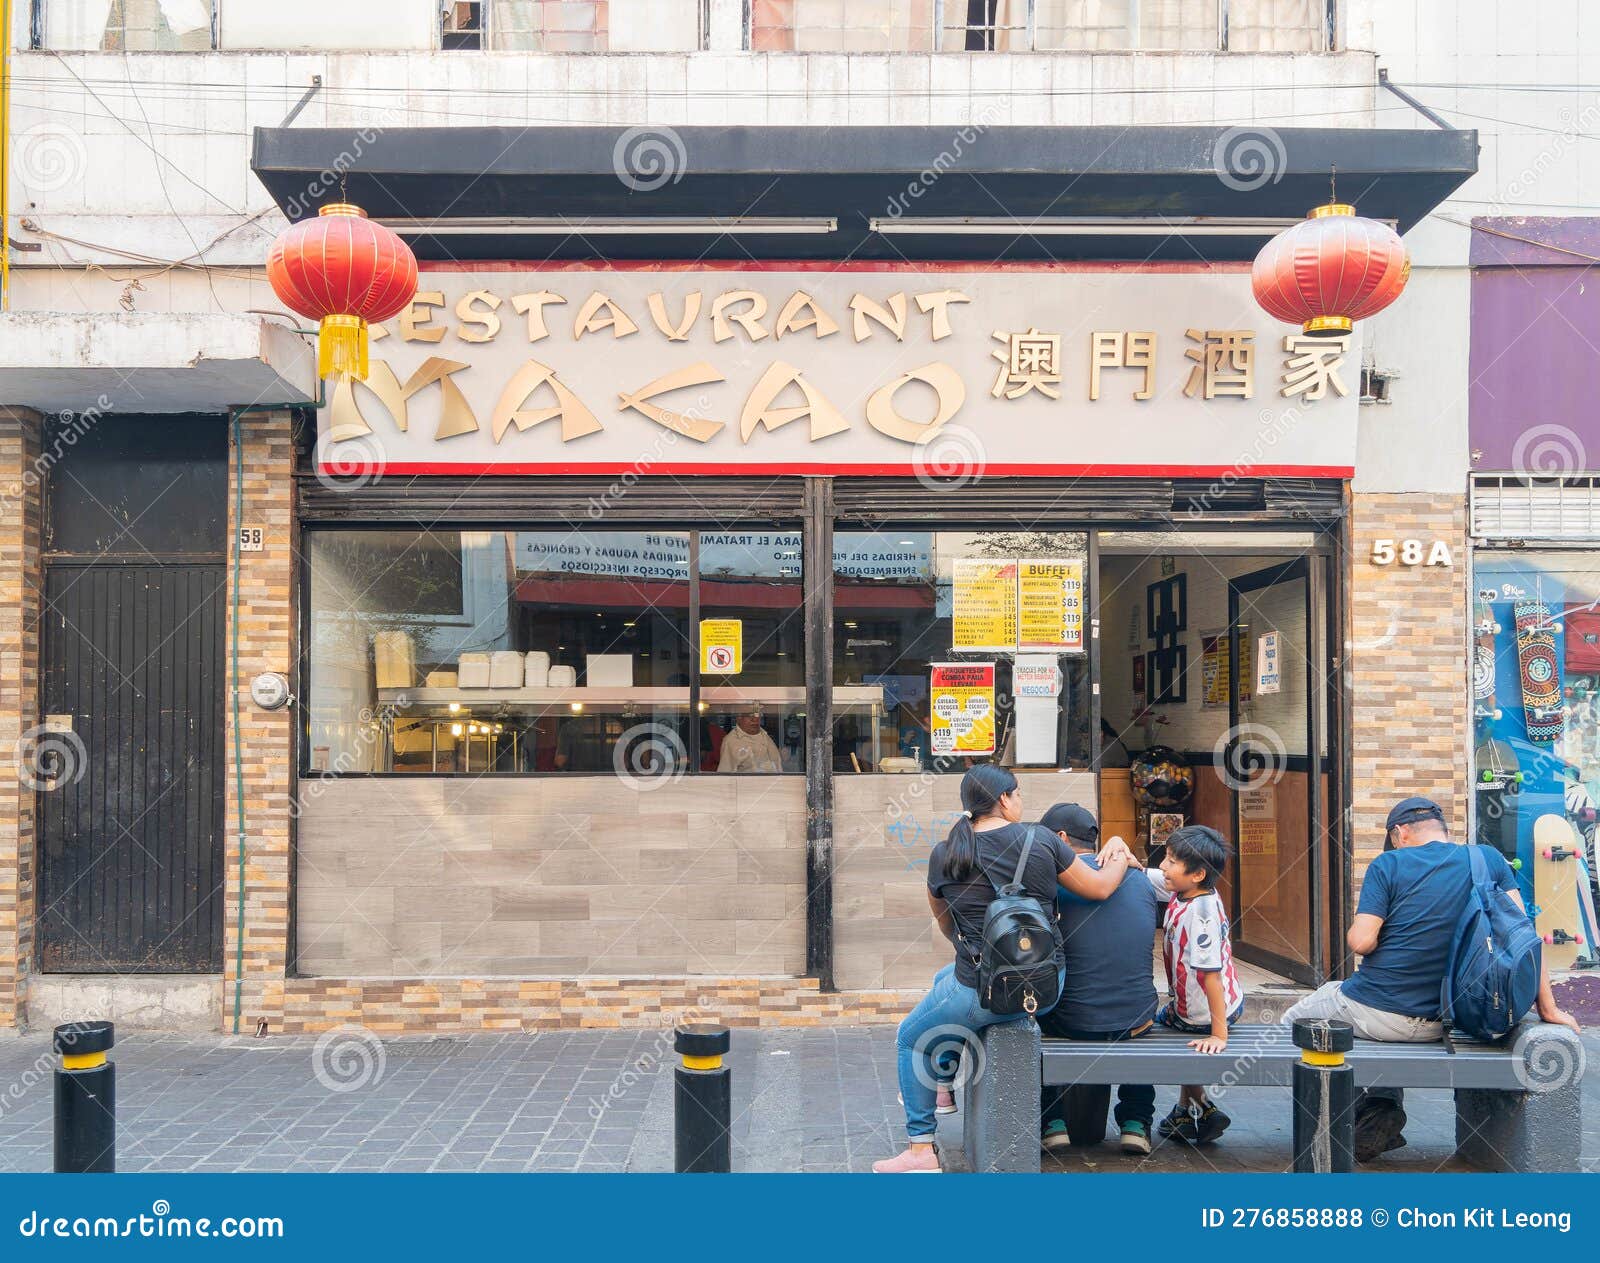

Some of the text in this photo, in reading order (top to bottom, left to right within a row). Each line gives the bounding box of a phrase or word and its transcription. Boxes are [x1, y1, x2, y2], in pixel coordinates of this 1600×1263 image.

[366, 289, 971, 343] ESTAURANT
[991, 328, 1350, 402] 澳門酒家
[331, 356, 966, 444] MACAO
[241, 529, 261, 544] 58
[1370, 538, 1453, 569] 58A
[1029, 565, 1072, 575] BUFFET
[1062, 580, 1080, 590] $119
[1062, 598, 1078, 607] $85
[1062, 614, 1080, 623] $119
[1061, 630, 1079, 639] $119
[1022, 685, 1049, 694] NEGOCIO
[934, 729, 951, 737] $119
